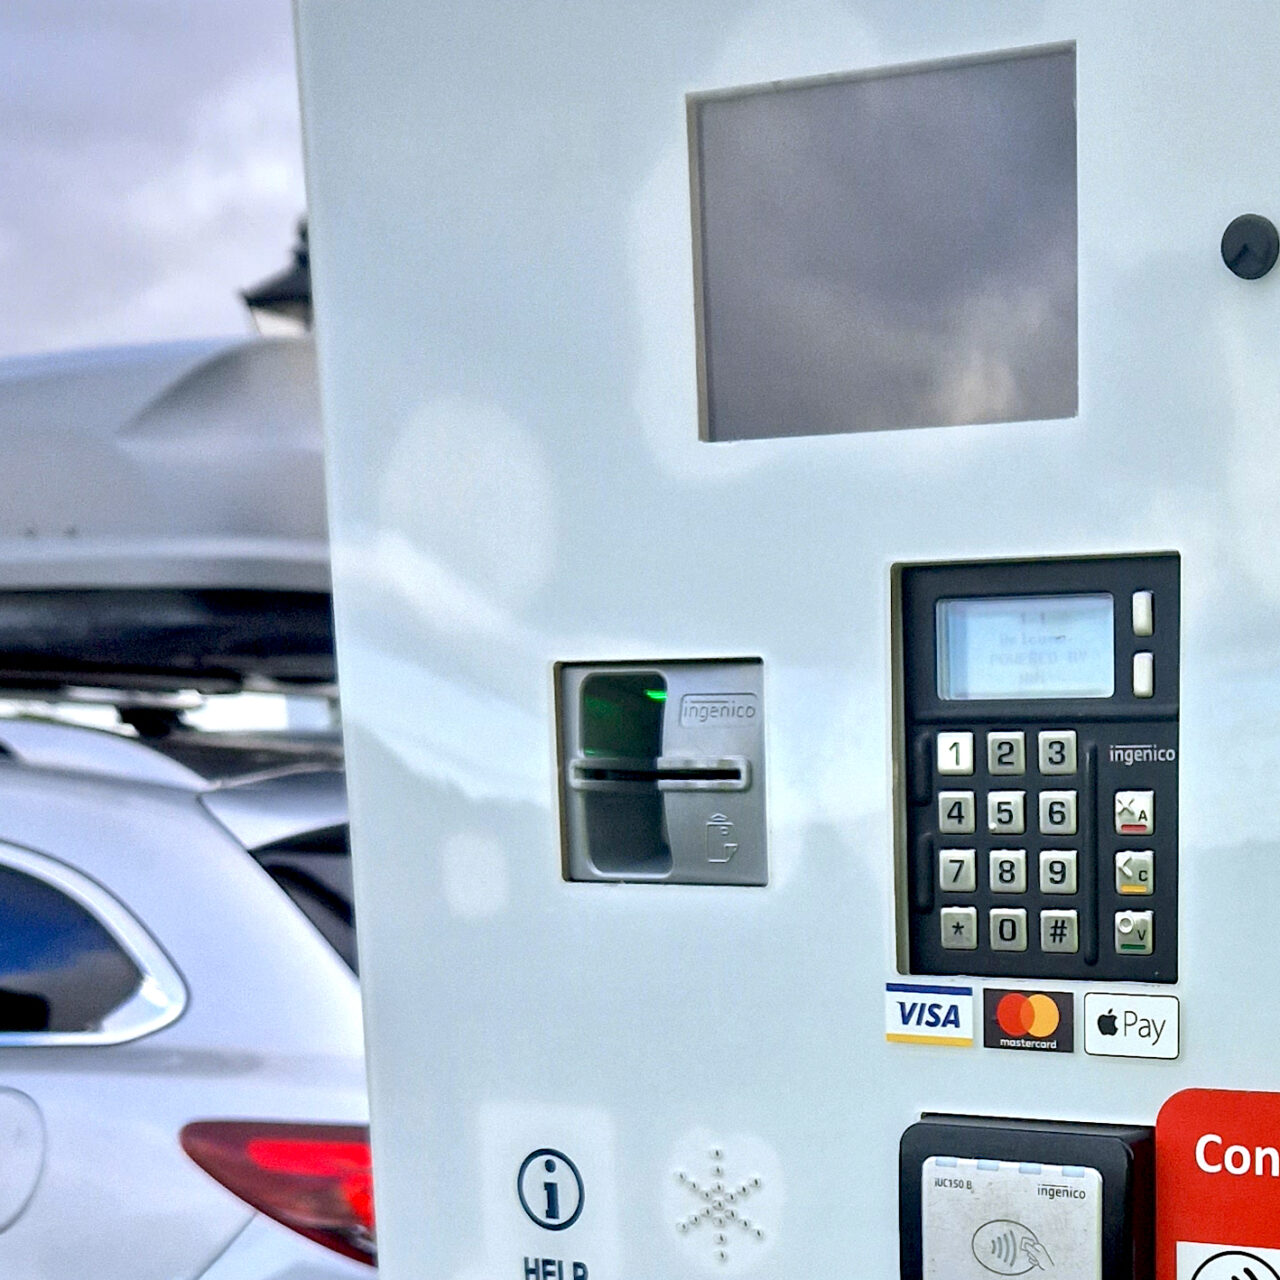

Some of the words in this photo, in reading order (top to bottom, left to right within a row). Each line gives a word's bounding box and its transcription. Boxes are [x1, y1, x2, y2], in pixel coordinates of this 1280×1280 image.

[683, 700, 756, 723] ingenico
[948, 742, 961, 766] 1
[997, 741, 1015, 766] 2
[1048, 740, 1066, 765] 3
[1109, 744, 1176, 765] ingenico
[947, 801, 965, 825] 4
[997, 801, 1014, 825] 5
[1048, 801, 1066, 825] 6
[1138, 810, 1148, 822] A
[949, 860, 965, 883] 7
[998, 860, 1016, 883] 8
[1049, 860, 1067, 884] 9
[999, 918, 1016, 941] 0
[1050, 919, 1067, 943] #
[897, 1001, 960, 1028] VISA
[1123, 1010, 1166, 1046] Pay
[1000, 1038, 1057, 1050] mastercard
[1037, 1183, 1086, 1200] ingenico
